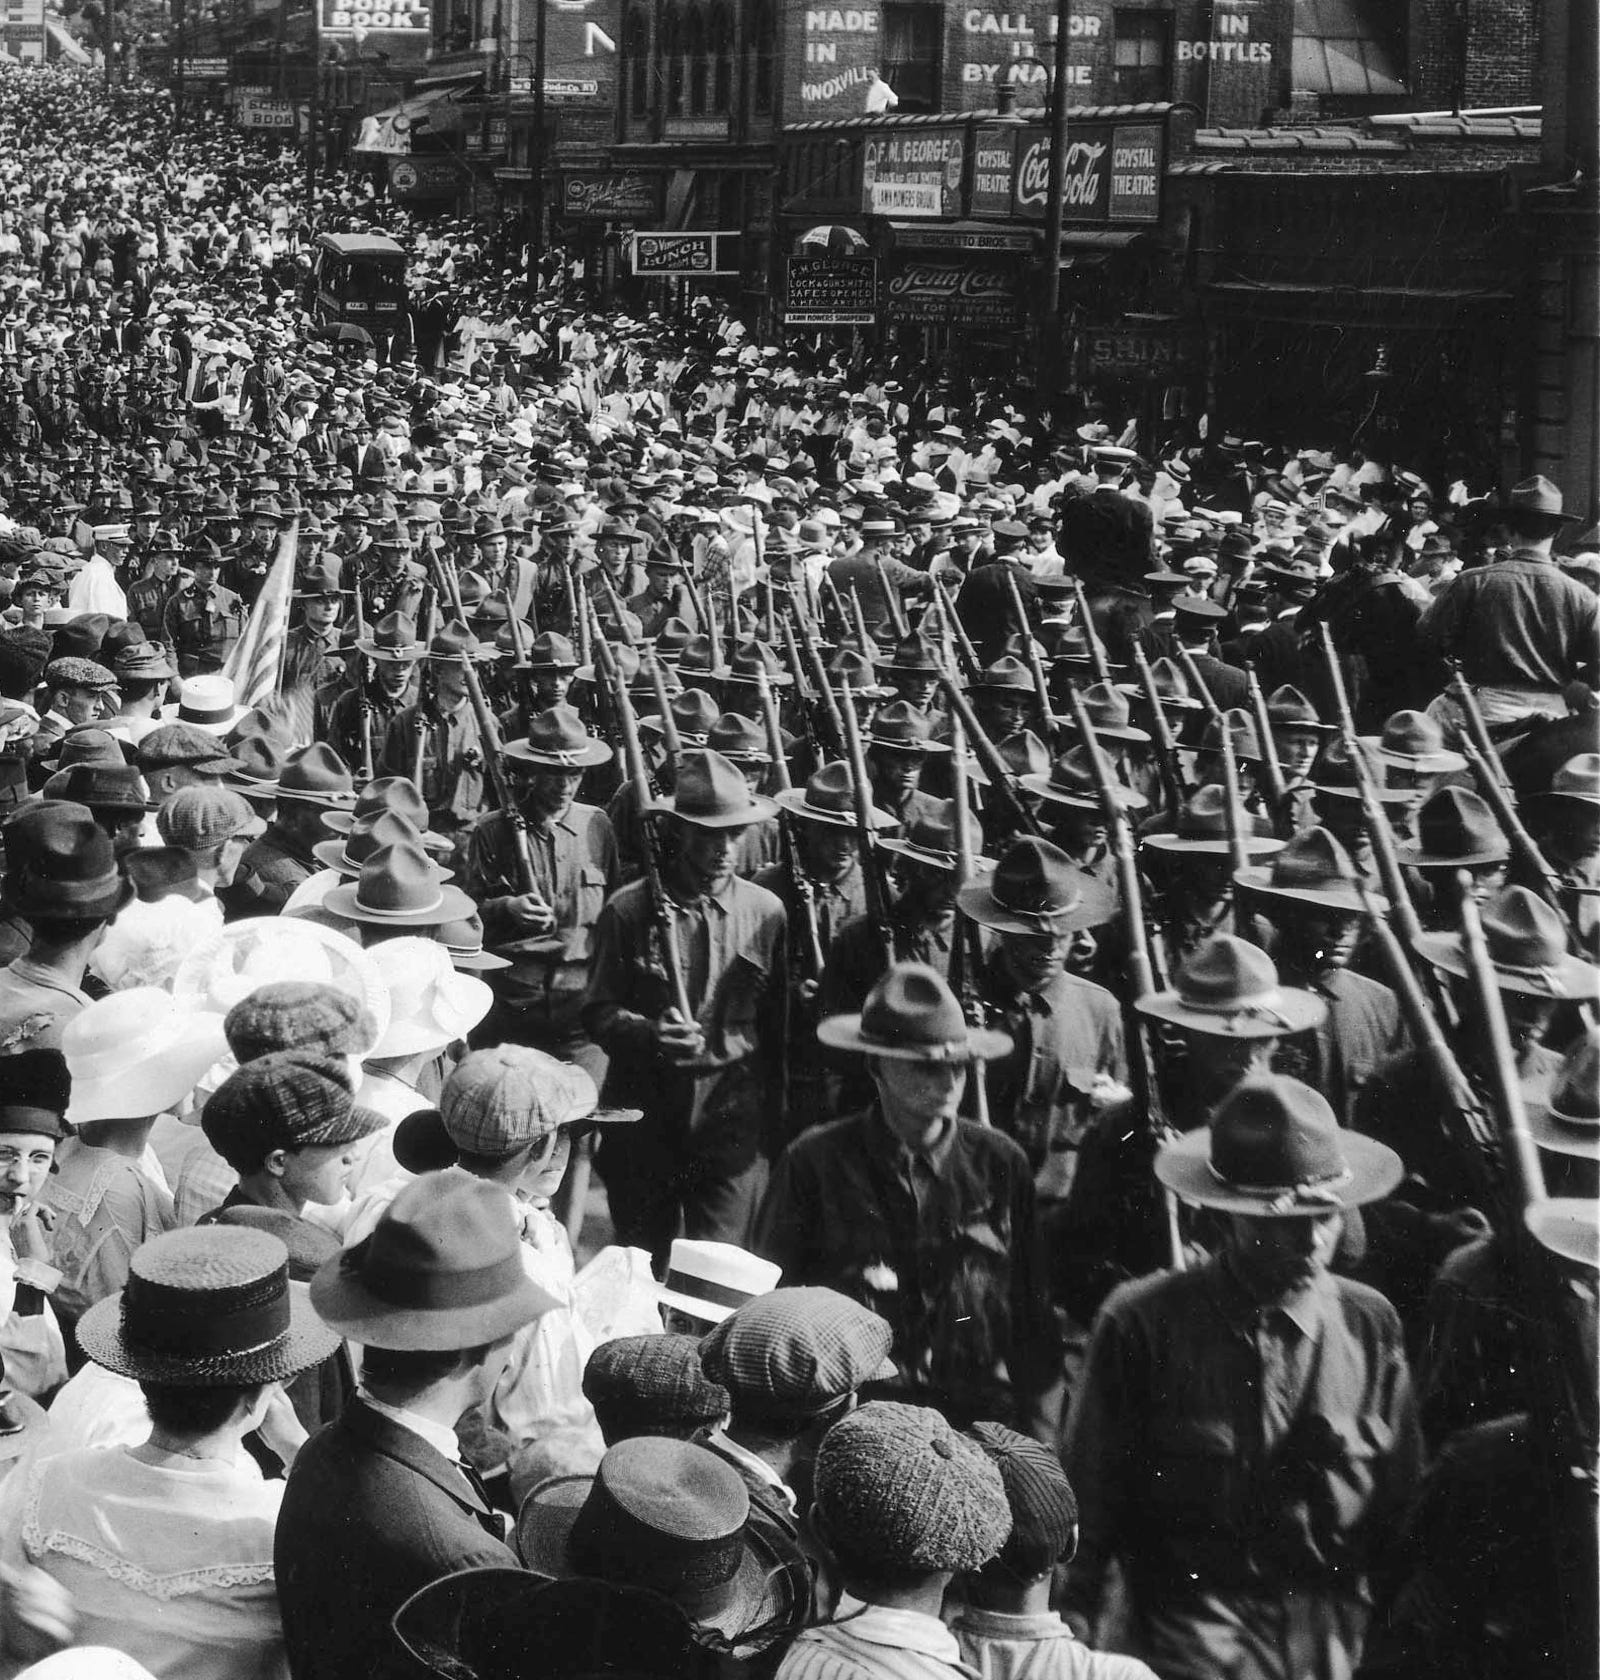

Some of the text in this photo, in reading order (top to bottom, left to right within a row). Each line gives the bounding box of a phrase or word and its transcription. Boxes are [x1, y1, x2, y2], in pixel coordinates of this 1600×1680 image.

[333, 11, 413, 26] BOOK
[806, 10, 878, 31] MADE
[965, 9, 1034, 34] CALL
[1219, 15, 1249, 35] IN
[807, 43, 836, 62] IN
[1177, 40, 1272, 62] BOTTLES
[963, 63, 999, 82] BY
[801, 66, 879, 101] KNOXVILL
[253, 114, 293, 125] BOOK
[903, 140, 951, 162] GEORGE
[977, 150, 1011, 168] CRYSTAL
[1114, 148, 1155, 168] CRYSTAL
[976, 174, 1011, 193] THEATRE
[1113, 175, 1156, 195] THEATRE
[641, 241, 706, 266] LUNCH
[790, 279, 816, 288] LOCK
[790, 289, 828, 297] SAFES
[807, 314, 833, 322] MOWERS
